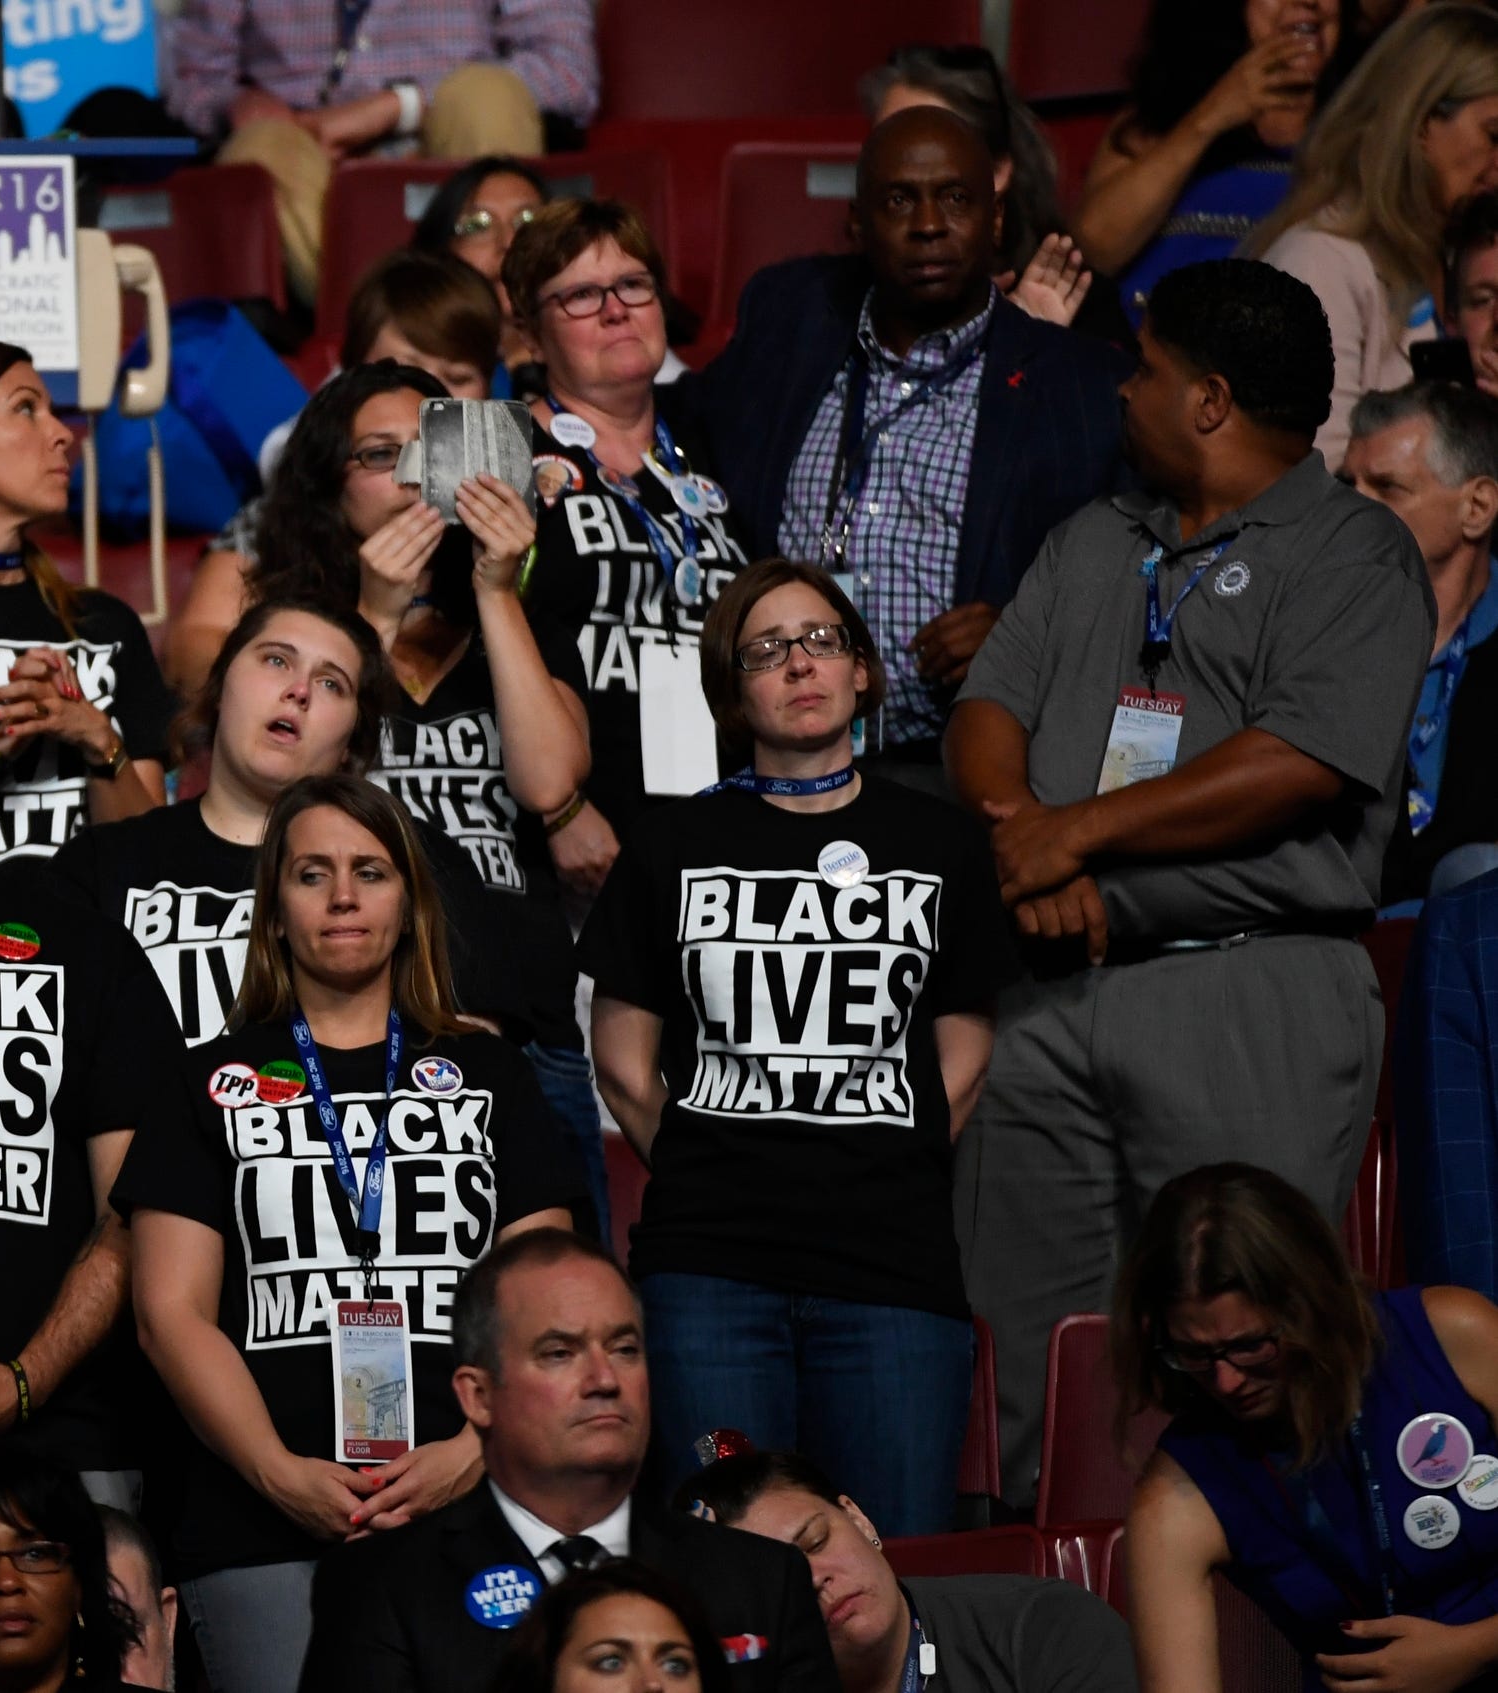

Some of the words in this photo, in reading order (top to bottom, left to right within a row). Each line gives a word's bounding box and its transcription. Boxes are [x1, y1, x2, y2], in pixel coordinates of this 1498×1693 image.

[1122, 695, 1182, 715] TUESDAY
[771, 781, 793, 793] Ford
[815, 779, 833, 790] DNC
[834, 772, 849, 785] 2016
[458, 837, 522, 888] TER
[823, 849, 861, 875] Bernie
[133, 891, 255, 950] BLA
[685, 878, 936, 950] BLACK
[687, 949, 924, 1050] LIVES
[306, 1057, 318, 1073] DNC
[215, 1071, 255, 1098] TPP
[311, 1071, 323, 1091] 2016
[693, 1053, 908, 1113] MATTER
[235, 1098, 486, 1158] BLACK
[333, 1141, 345, 1157] DNC
[338, 1155, 350, 1175] 2016
[370, 1166, 382, 1190] Ford
[240, 1158, 493, 1266] LIVES
[253, 1269, 459, 1338] MATTE
[341, 1311, 400, 1326] TUESDAY
[356, 1378, 362, 1388] 2
[346, 1446, 371, 1455] FLOOR
[484, 1569, 519, 1589] I'M
[471, 1580, 536, 1605] WITH
[482, 1597, 531, 1619] HER
